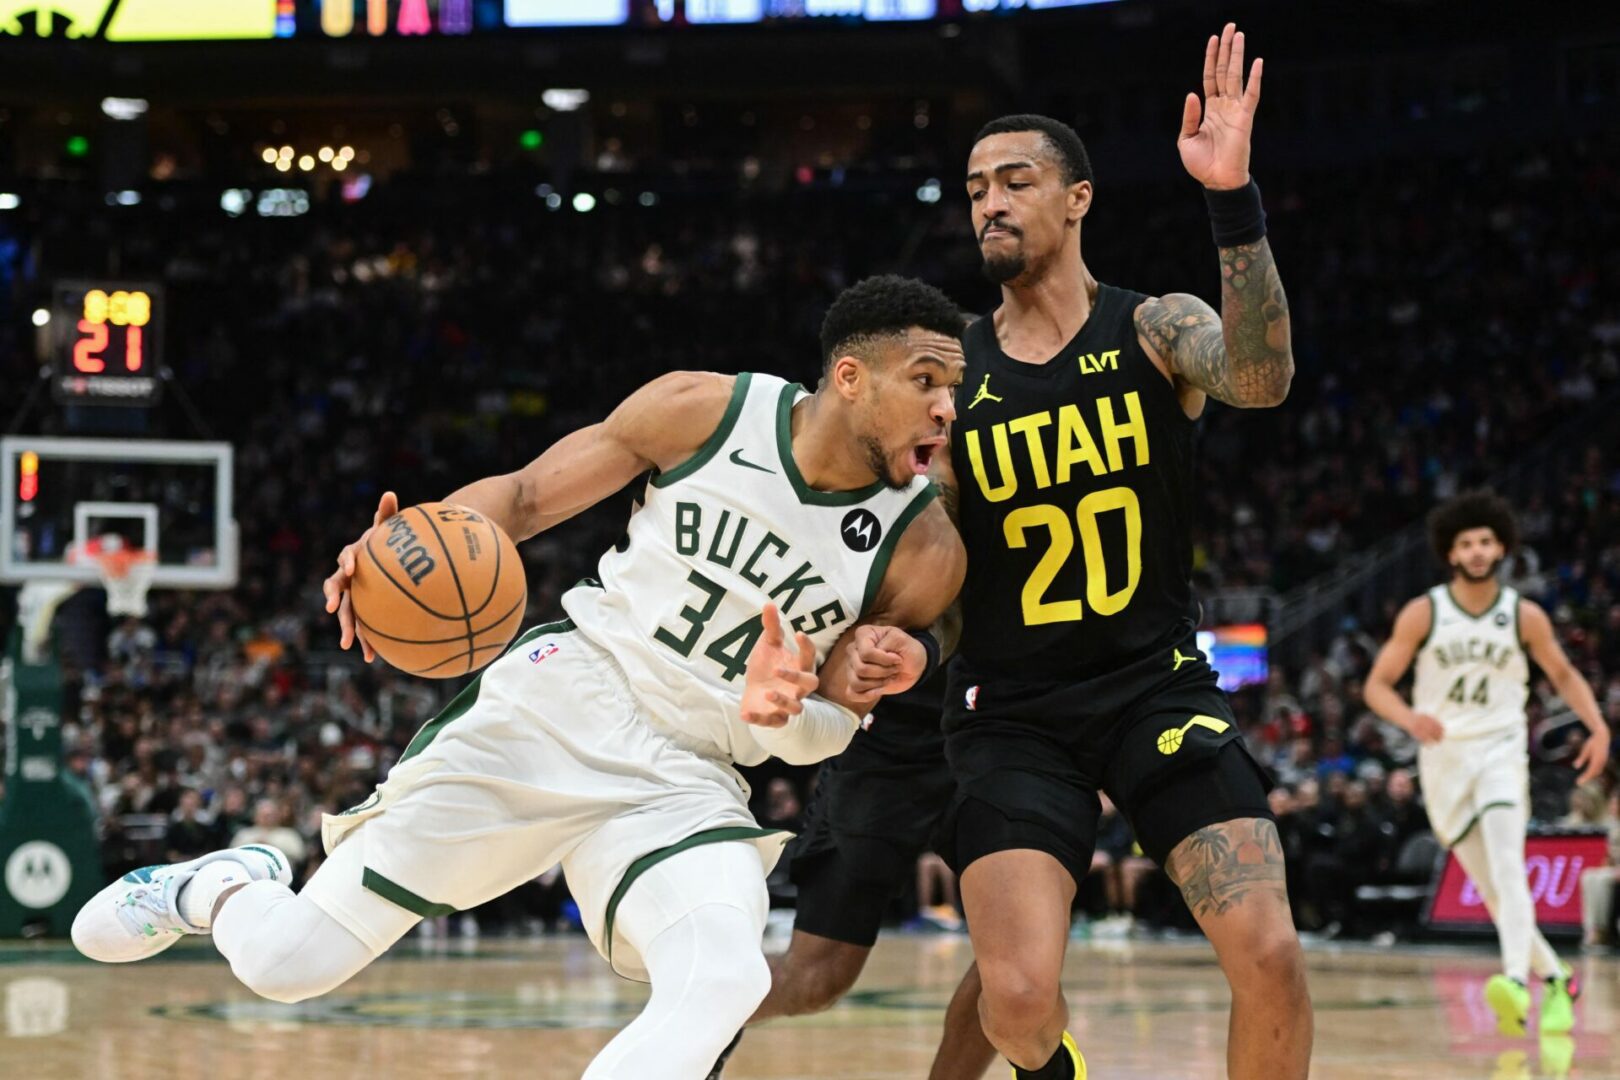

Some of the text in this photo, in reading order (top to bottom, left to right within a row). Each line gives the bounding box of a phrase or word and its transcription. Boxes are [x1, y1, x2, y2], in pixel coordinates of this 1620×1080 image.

[73, 319, 143, 373] 21
[1078, 350, 1121, 375] LVT
[965, 391, 1150, 503] UTAH
[385, 514, 435, 587] Wilso
[675, 501, 847, 635] BUCKS
[1003, 487, 1143, 626] 20
[653, 568, 764, 683] 34
[1446, 674, 1489, 705] 44
